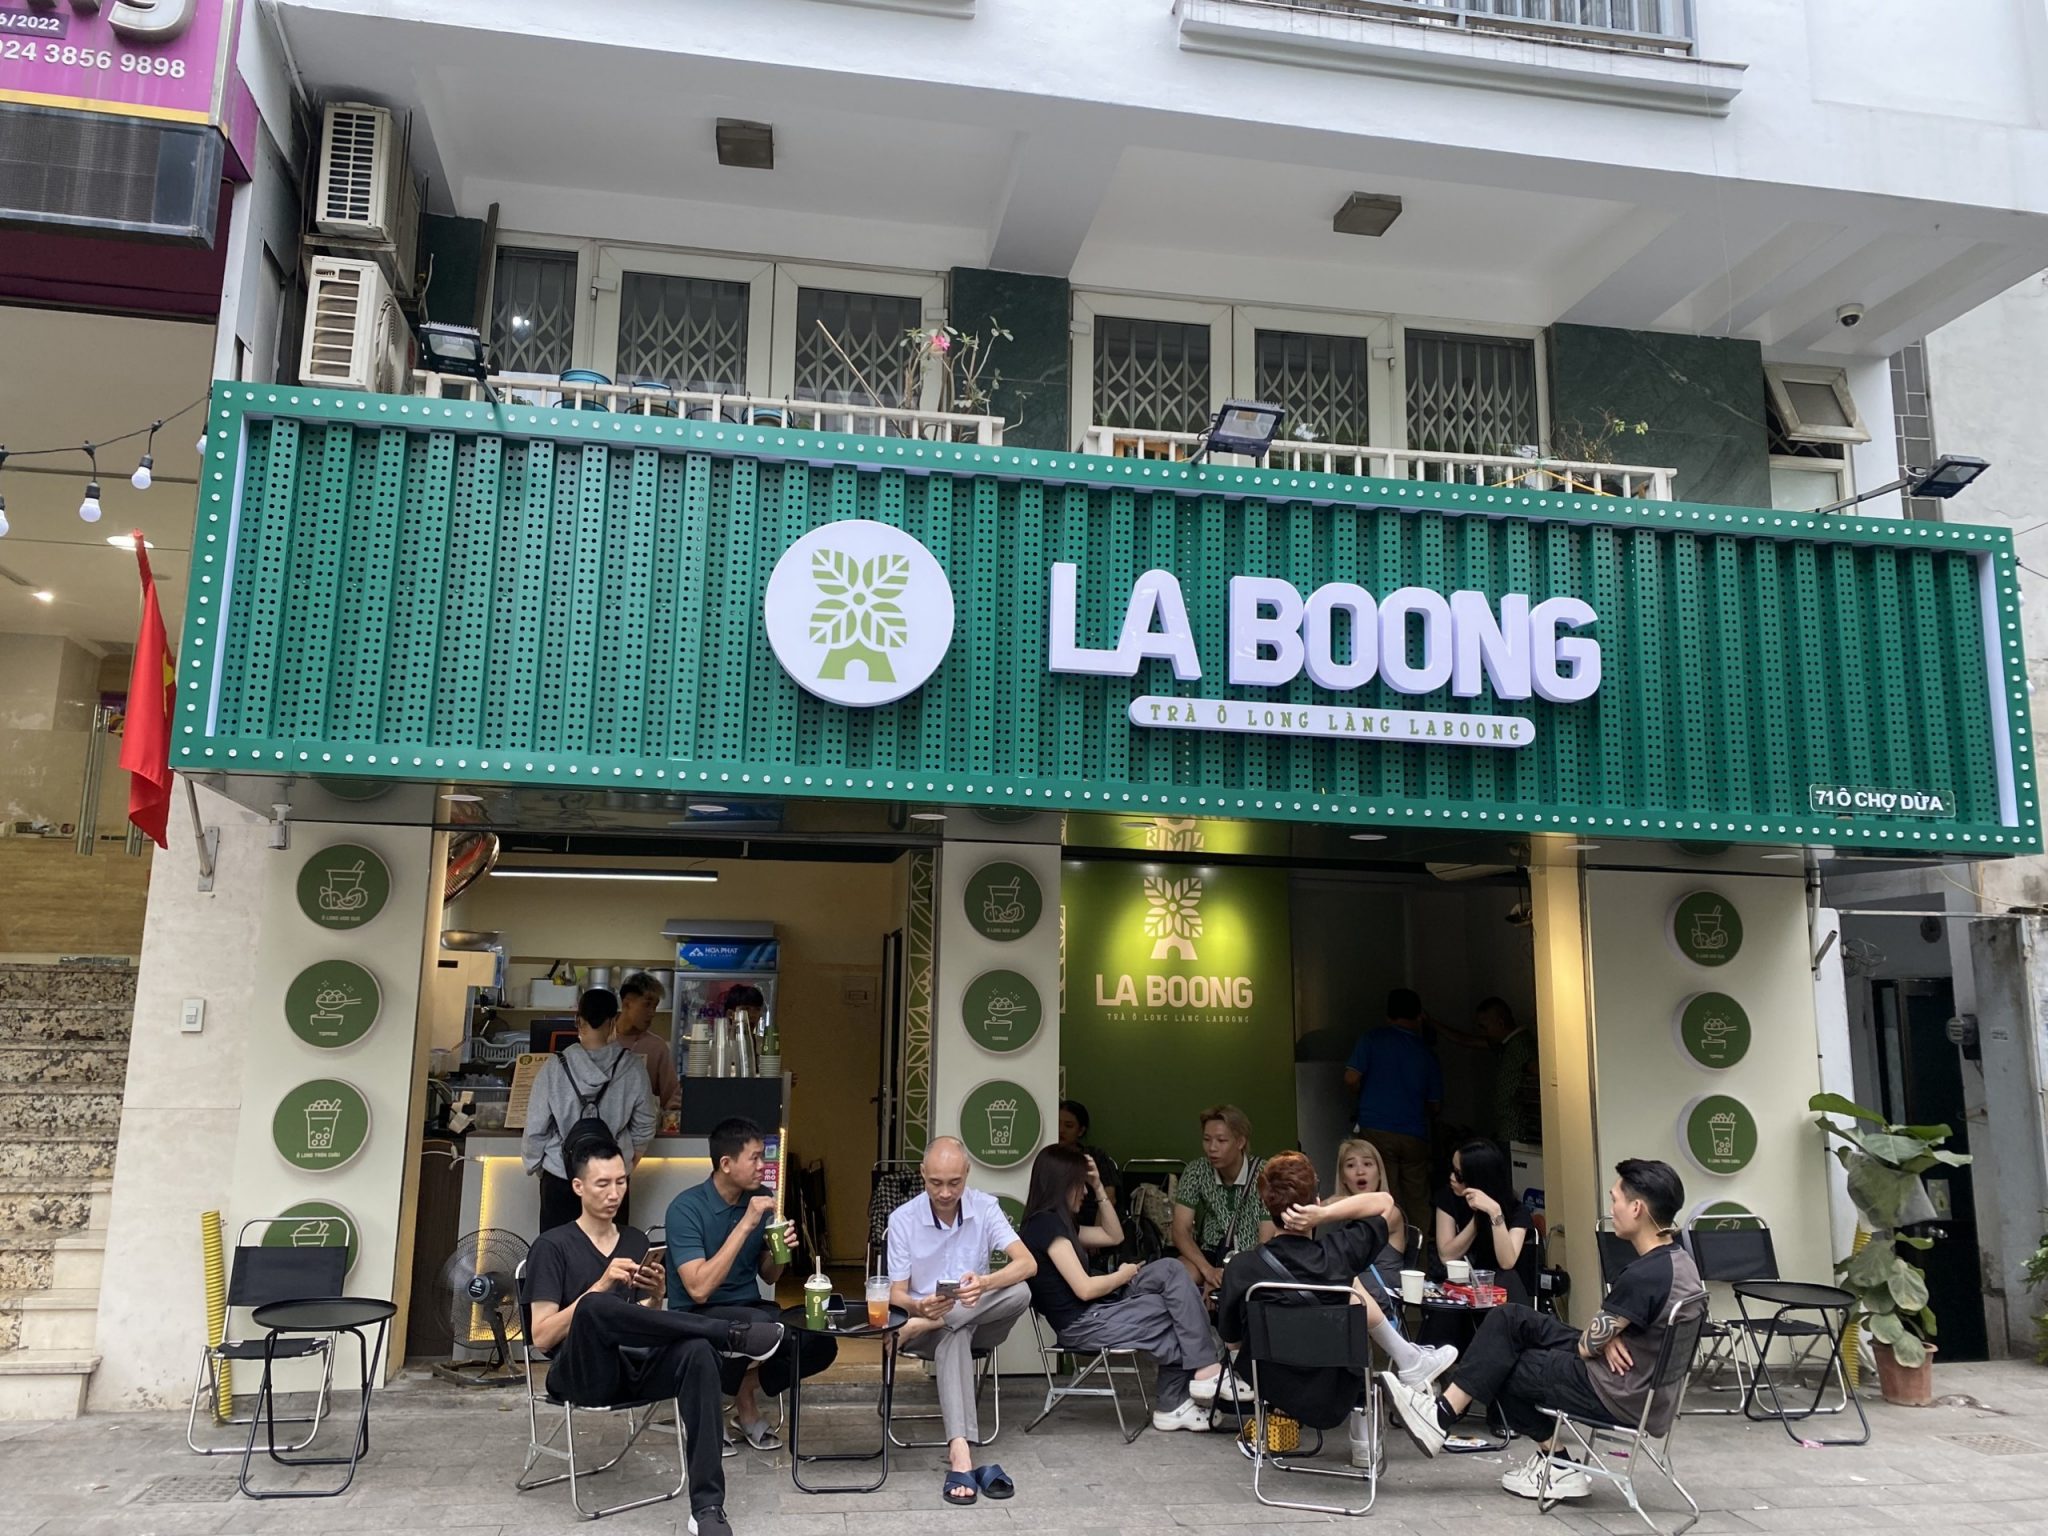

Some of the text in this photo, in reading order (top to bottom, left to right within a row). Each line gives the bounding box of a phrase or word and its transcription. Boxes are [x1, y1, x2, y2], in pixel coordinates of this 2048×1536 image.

[0, 13, 60, 31] 6/2022
[0, 40, 186, 79] 24 3856 9898
[1049, 562, 1602, 703] LA BOONG
[1150, 703, 1520, 741] TRÀ Ô LONG LÀNG LABOONG
[1815, 787, 1944, 812] 71 Ô CHỢ DỪA
[1095, 974, 1253, 1009] LA BOONG
